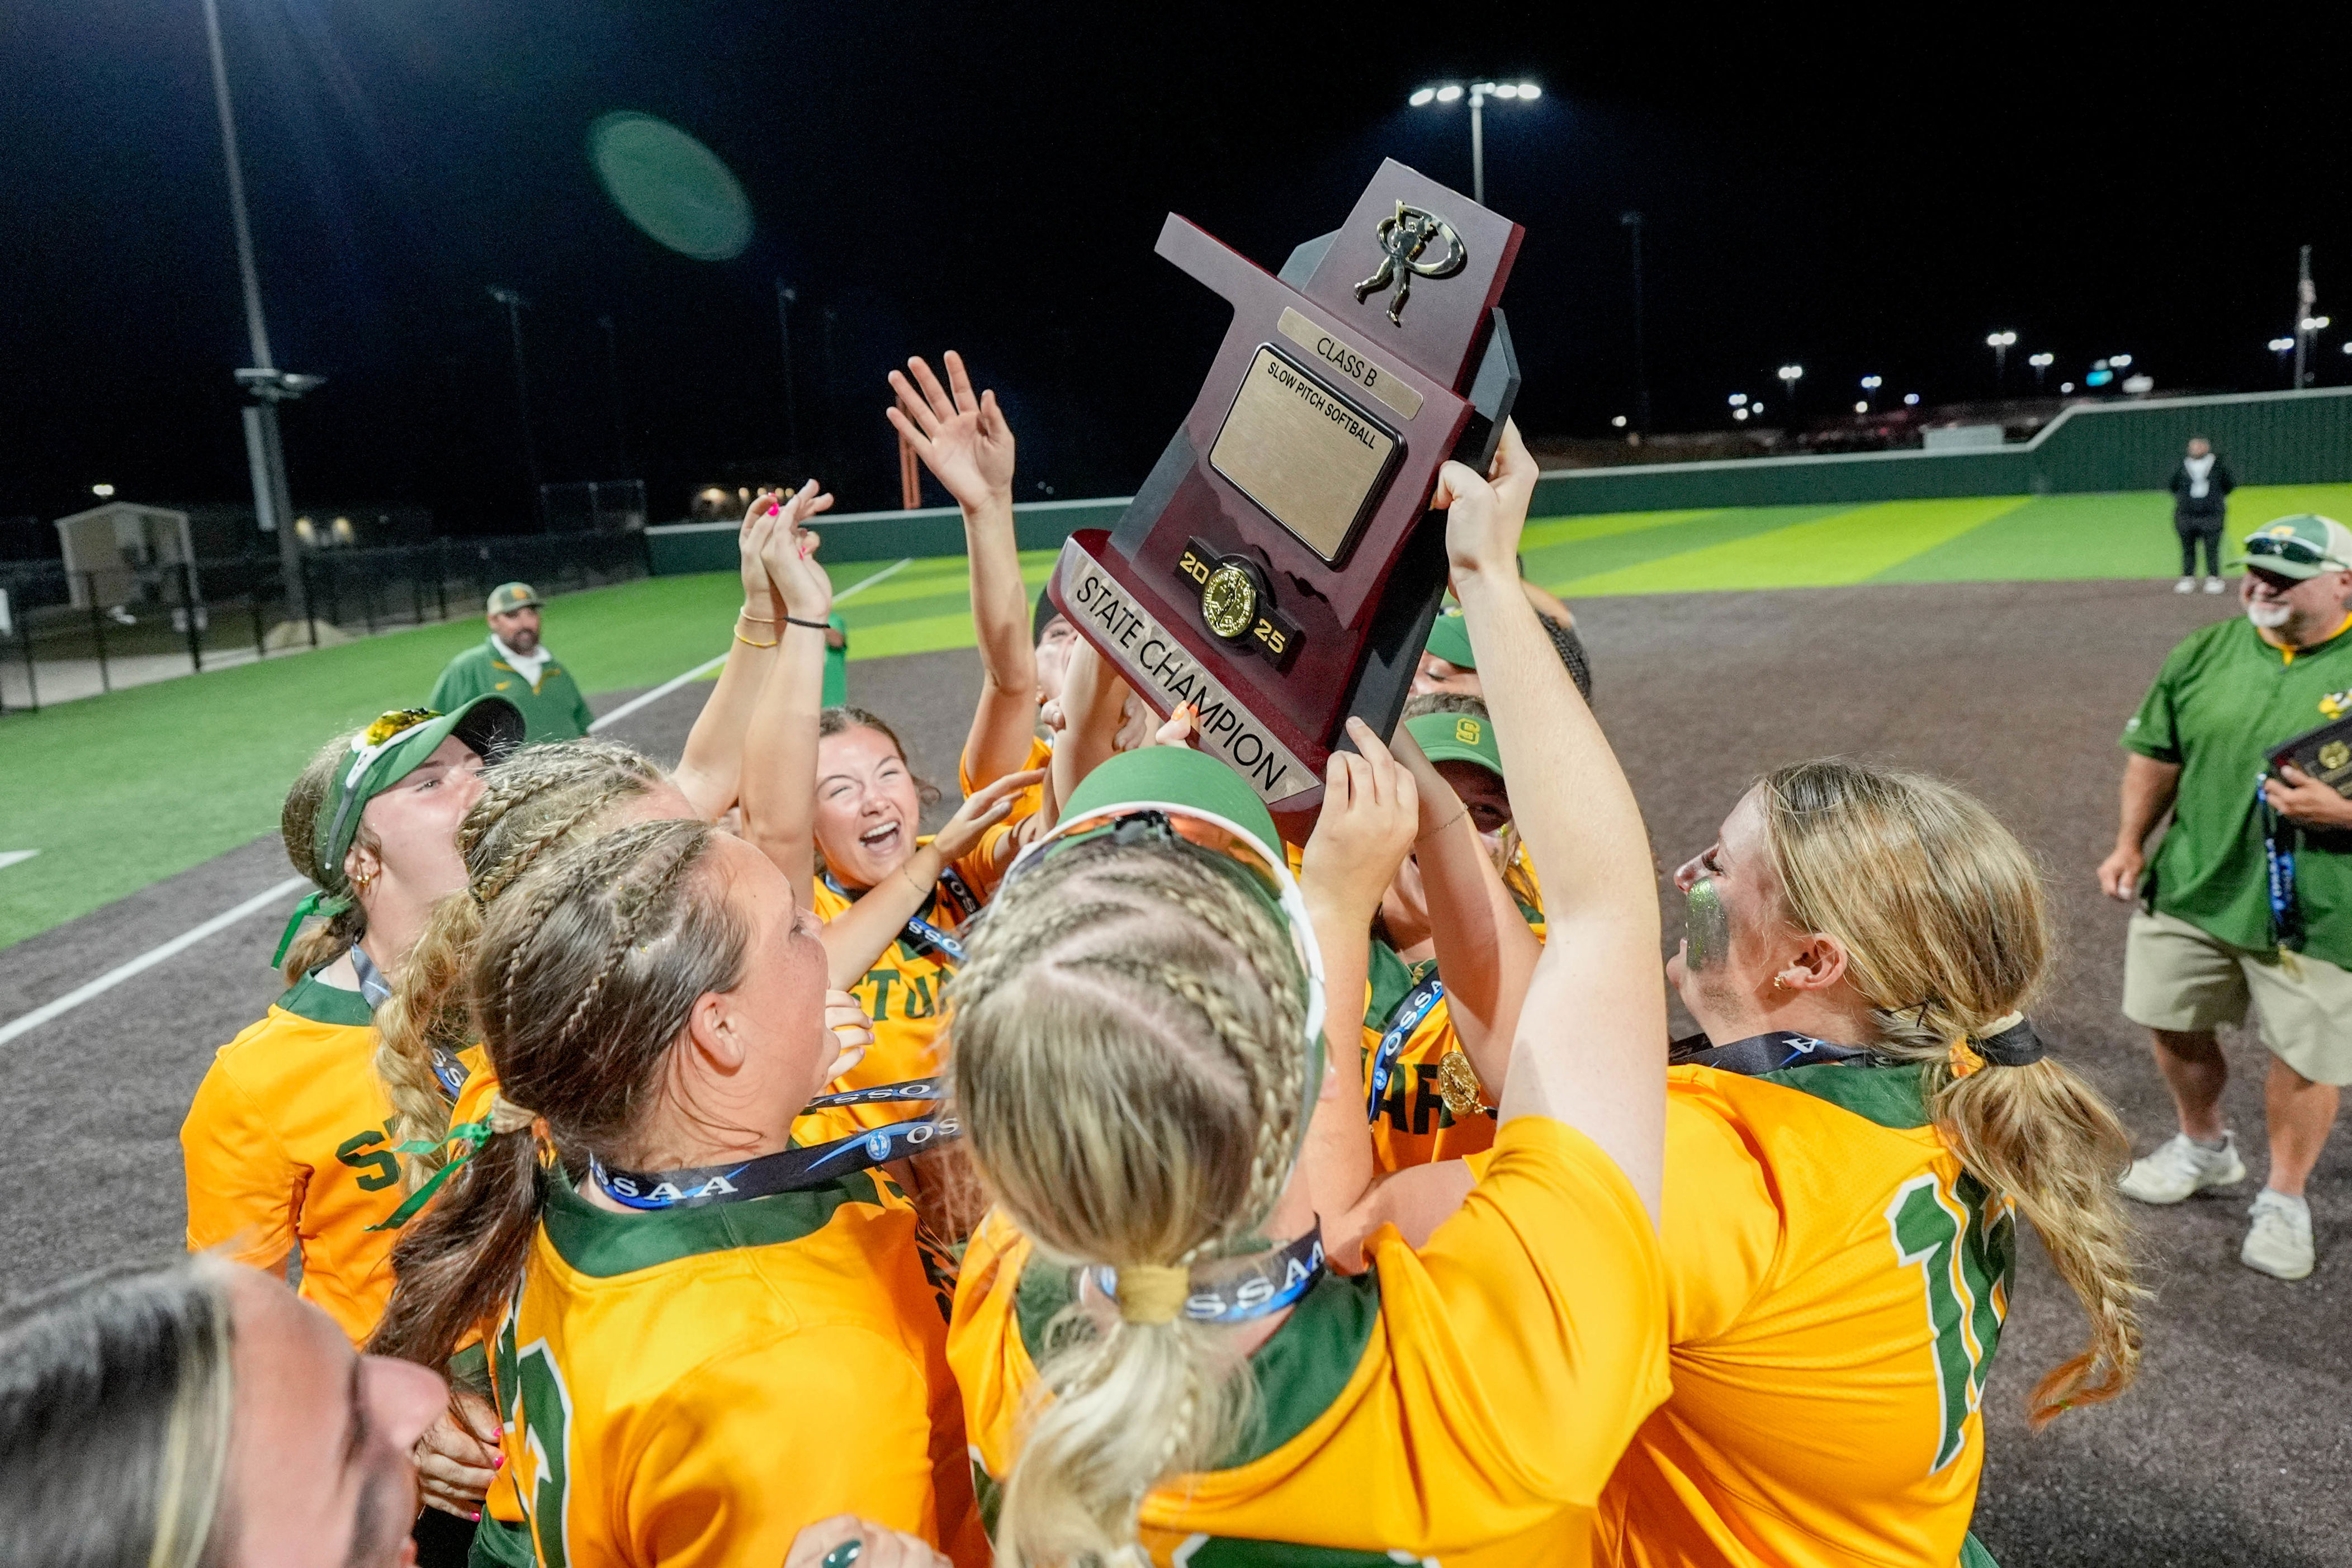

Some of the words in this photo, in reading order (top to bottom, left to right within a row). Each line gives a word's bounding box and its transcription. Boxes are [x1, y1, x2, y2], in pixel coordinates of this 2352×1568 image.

[1317, 338, 1365, 378] CLASS
[1364, 368, 1378, 387] B
[1267, 362, 1297, 390] SLOW
[1295, 381, 1326, 411] PITCH
[1324, 403, 1376, 449] SOFTBALL
[1179, 551, 1210, 585] 20
[1253, 618, 1286, 653] 25
[1076, 576, 1145, 650] STATE
[1139, 639, 1288, 792] CHAMPION
[806, 1084, 931, 1107] OSS
[590, 1150, 739, 1201] SSAA
[1185, 1240, 1325, 1320] SSAA
